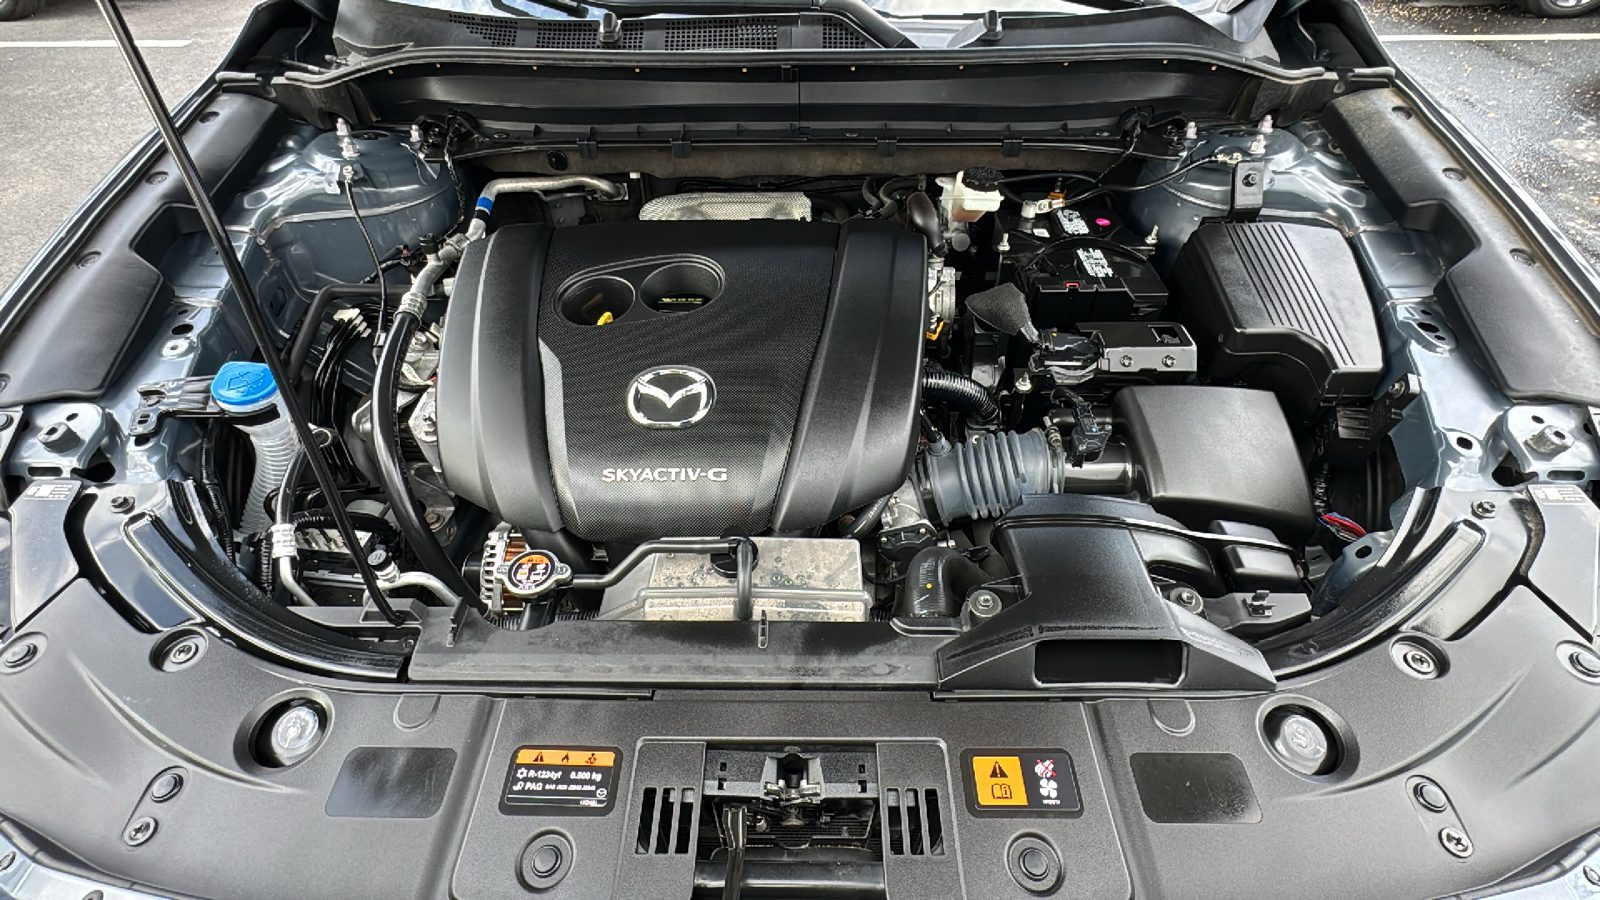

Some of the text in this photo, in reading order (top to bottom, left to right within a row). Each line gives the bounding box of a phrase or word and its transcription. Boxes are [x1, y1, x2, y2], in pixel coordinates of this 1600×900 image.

[602, 468, 728, 482] SKYACTIV-G
[528, 769, 562, 780] R-1234yf
[591, 772, 603, 782] kg
[524, 781, 543, 791] PAG
